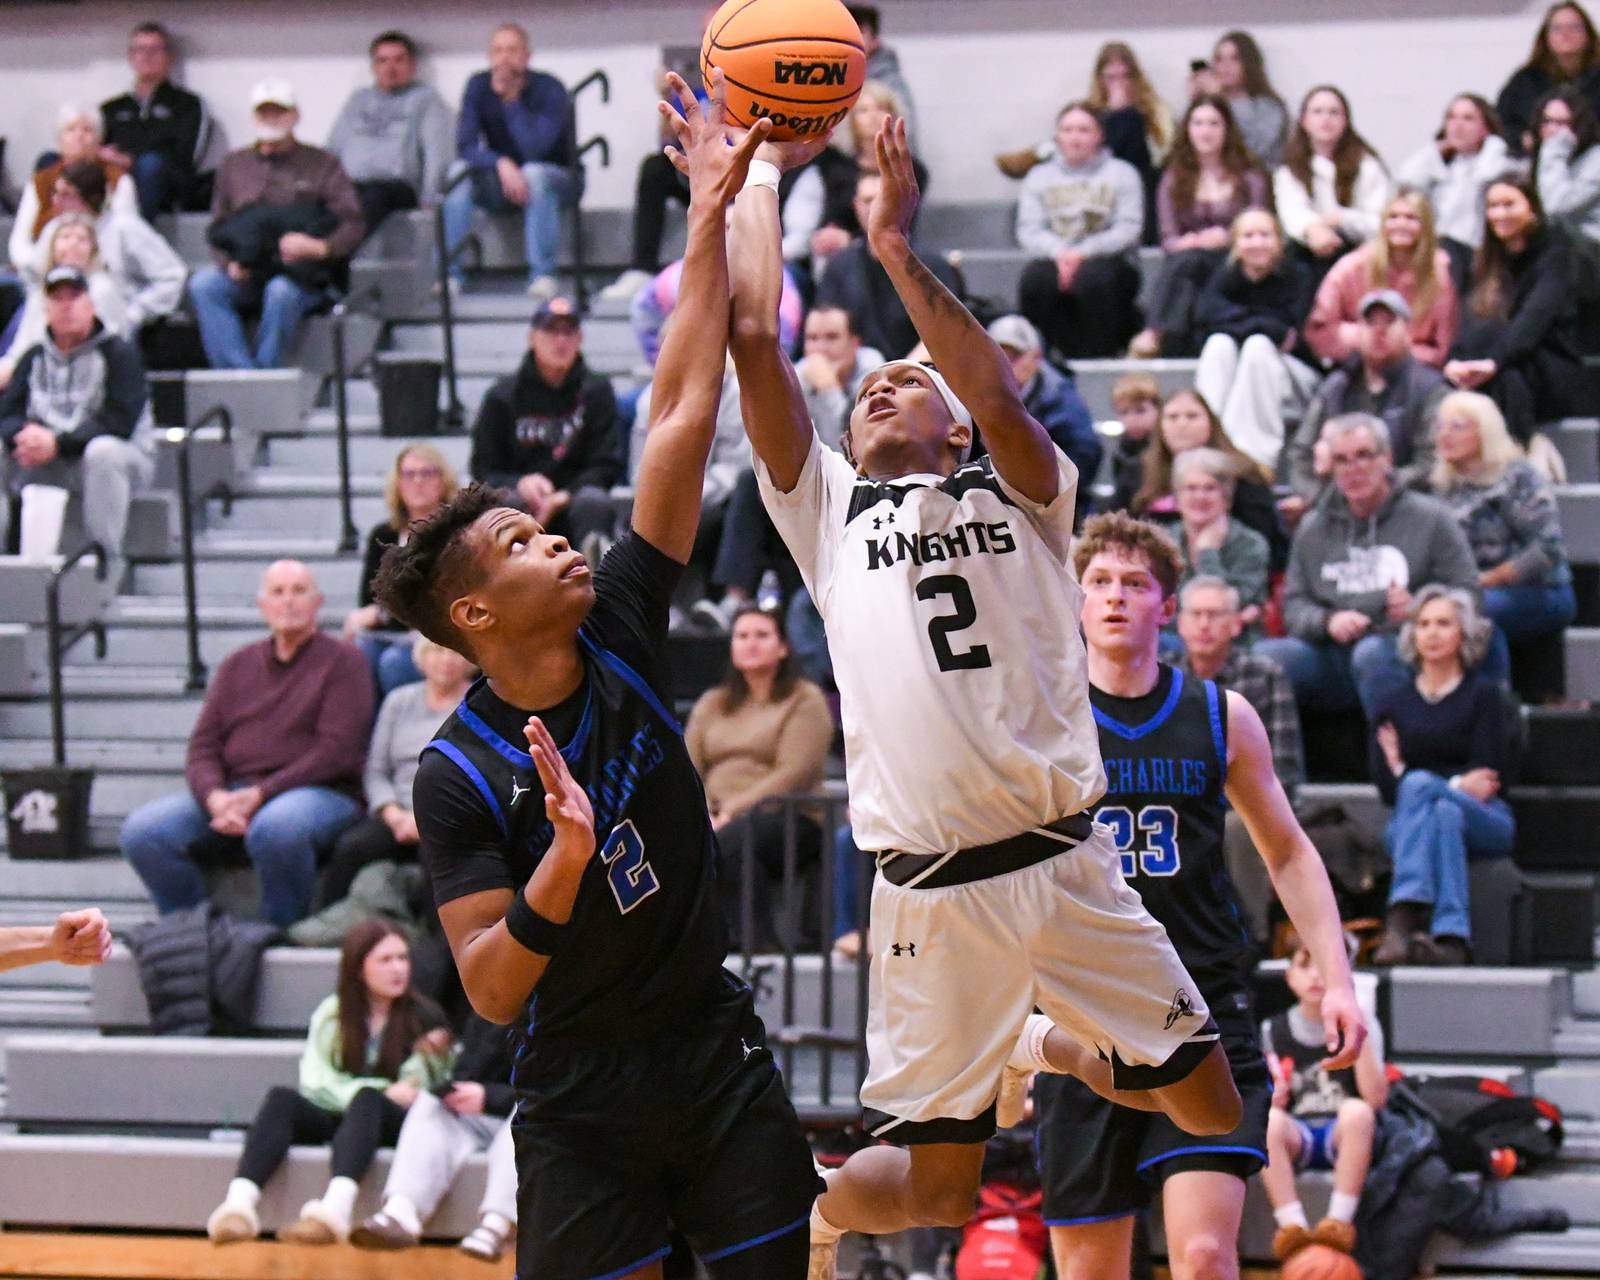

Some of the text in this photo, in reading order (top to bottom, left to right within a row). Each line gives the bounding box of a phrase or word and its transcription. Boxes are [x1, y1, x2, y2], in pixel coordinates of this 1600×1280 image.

[774, 60, 848, 86] NCAA
[749, 101, 849, 136] Wilson
[865, 521, 1017, 571] KNGHTS
[915, 574, 993, 673] 2
[1104, 757, 1208, 796] CHARLES
[600, 817, 661, 916] 2
[1093, 805, 1182, 878] 23
